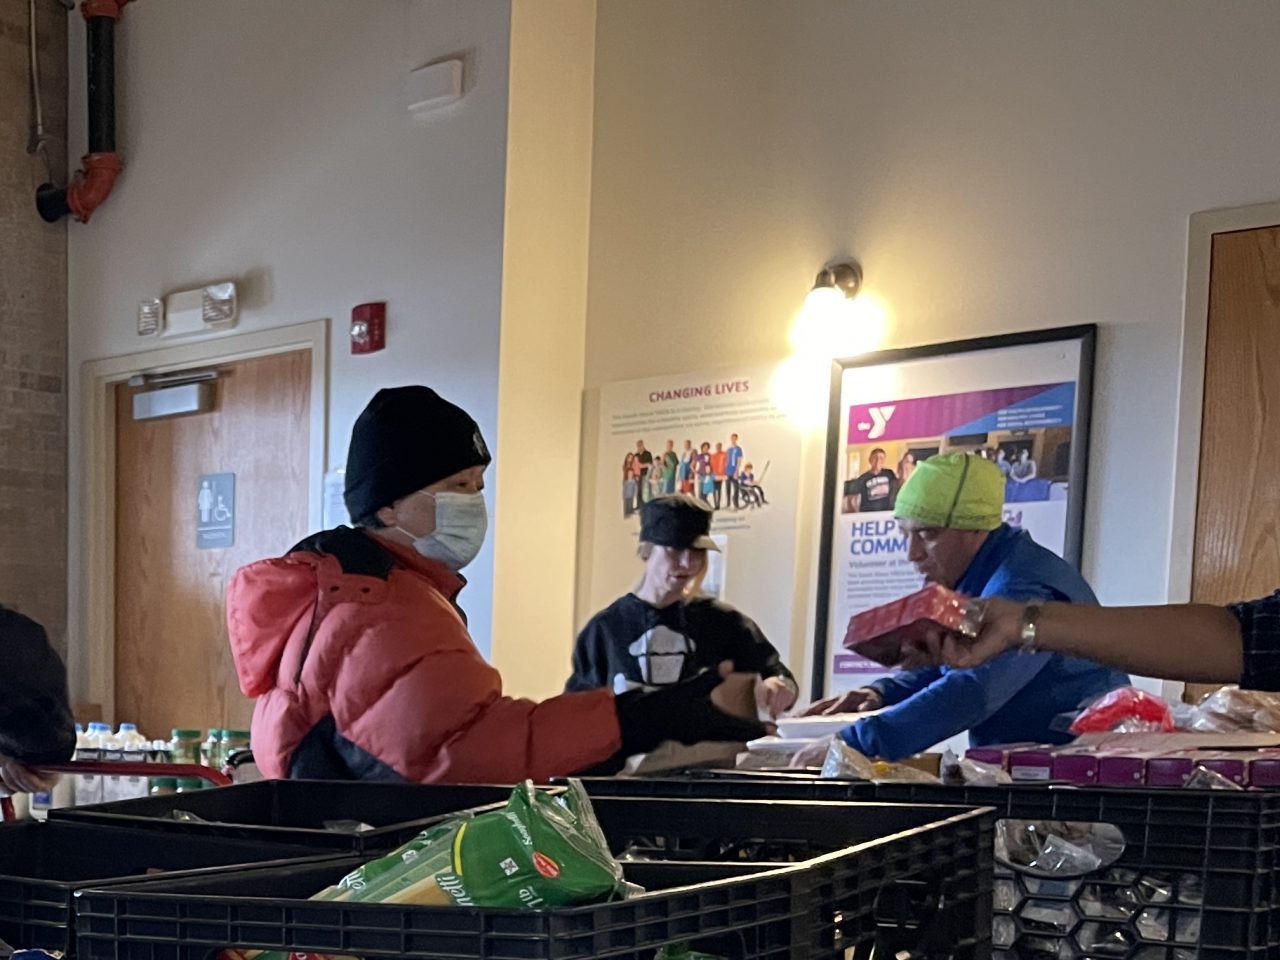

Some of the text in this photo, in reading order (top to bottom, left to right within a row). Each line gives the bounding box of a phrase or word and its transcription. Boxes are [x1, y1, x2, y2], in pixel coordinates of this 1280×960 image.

[649, 380, 750, 403] CHANGING LIVES
[851, 520, 895, 538] HELP
